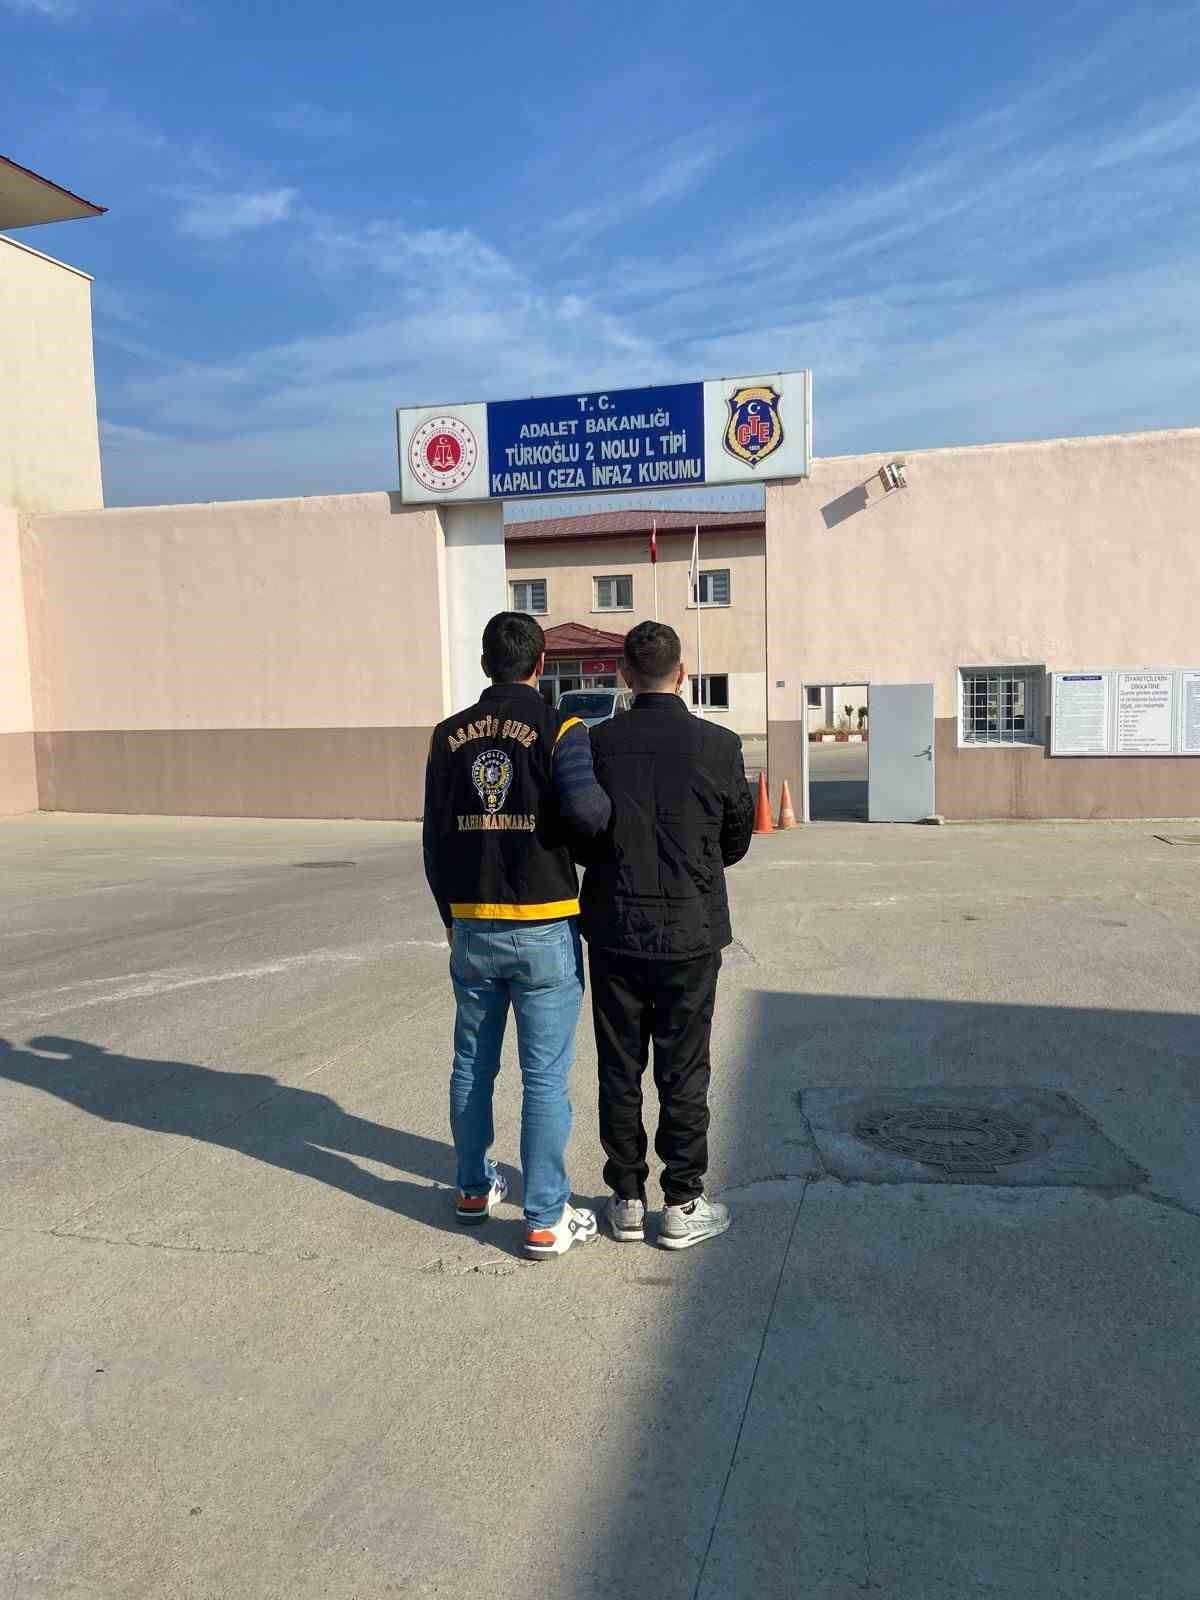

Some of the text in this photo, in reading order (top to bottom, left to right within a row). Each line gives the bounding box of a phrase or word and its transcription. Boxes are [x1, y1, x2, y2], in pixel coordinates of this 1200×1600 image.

[519, 407, 670, 439] ADALET BAKANLIĞI
[505, 428, 687, 467] TÜRKOĞLU 2 NOLU L TİPİ
[491, 458, 702, 493] KAPALI CEZA İNFAZ KURUMU
